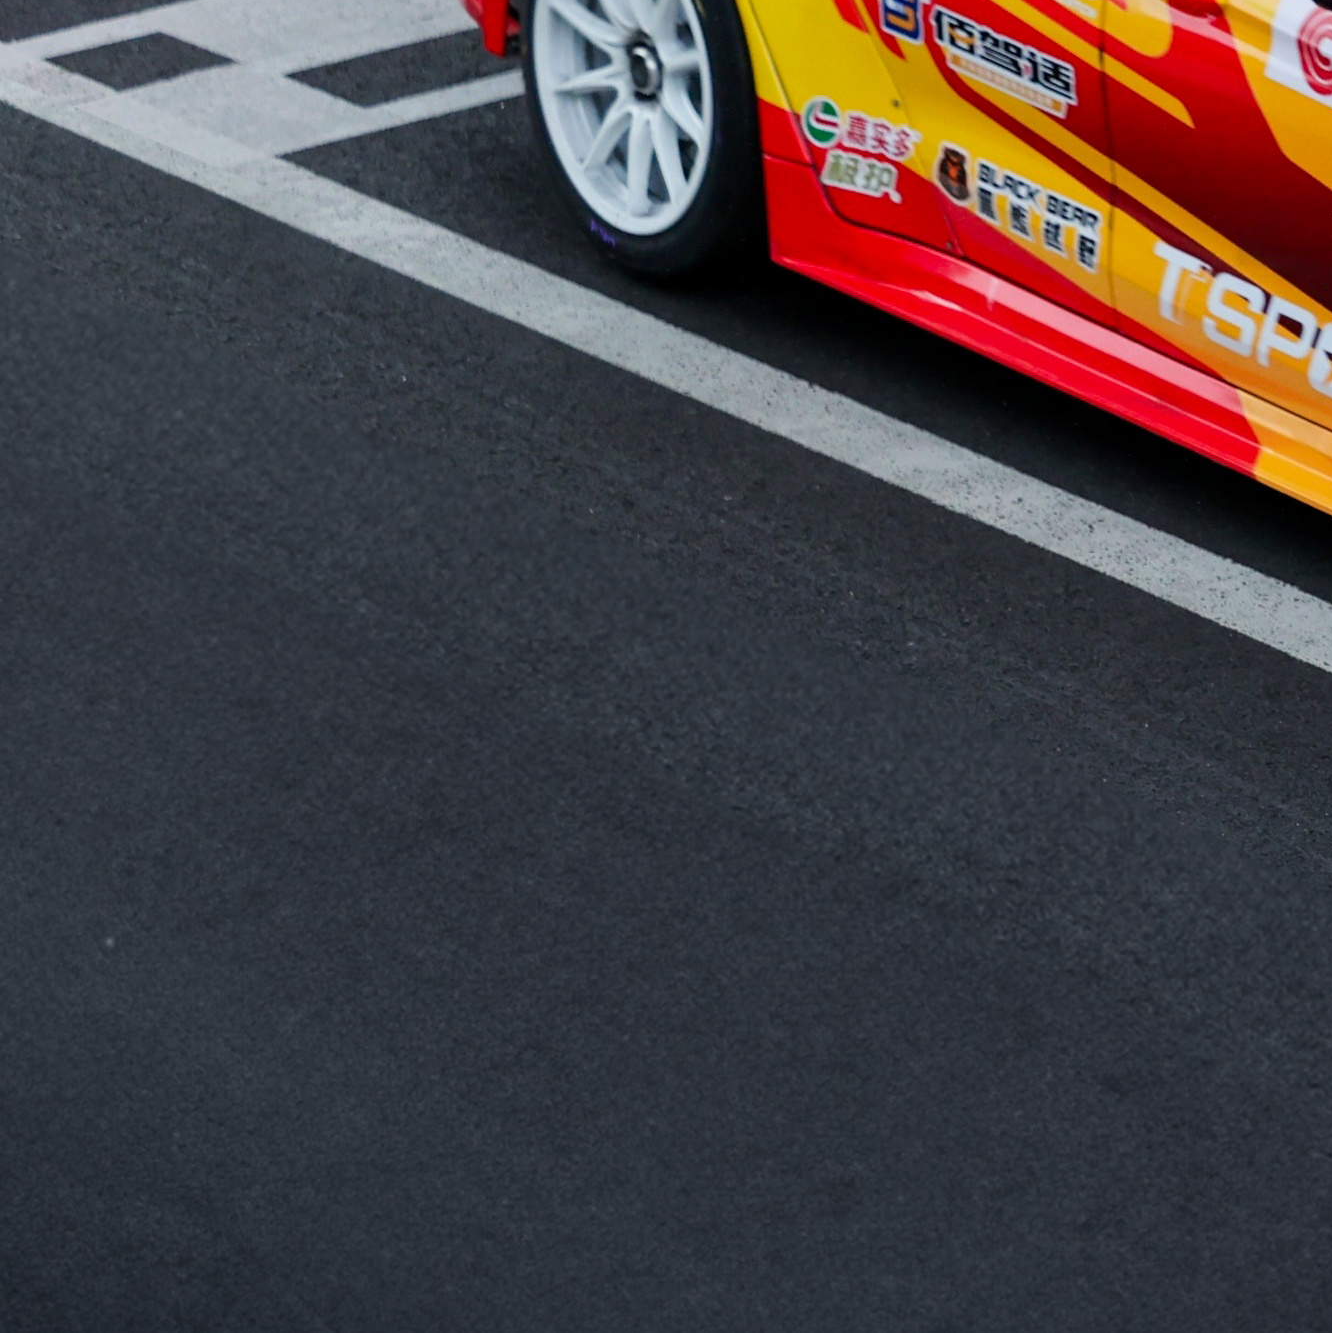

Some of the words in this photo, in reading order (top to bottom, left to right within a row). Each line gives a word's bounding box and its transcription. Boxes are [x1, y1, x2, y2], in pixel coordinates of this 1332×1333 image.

[933, 8, 1076, 104] 佰驾适
[978, 163, 1041, 204] BLACK
[1047, 194, 1099, 231] BEAR
